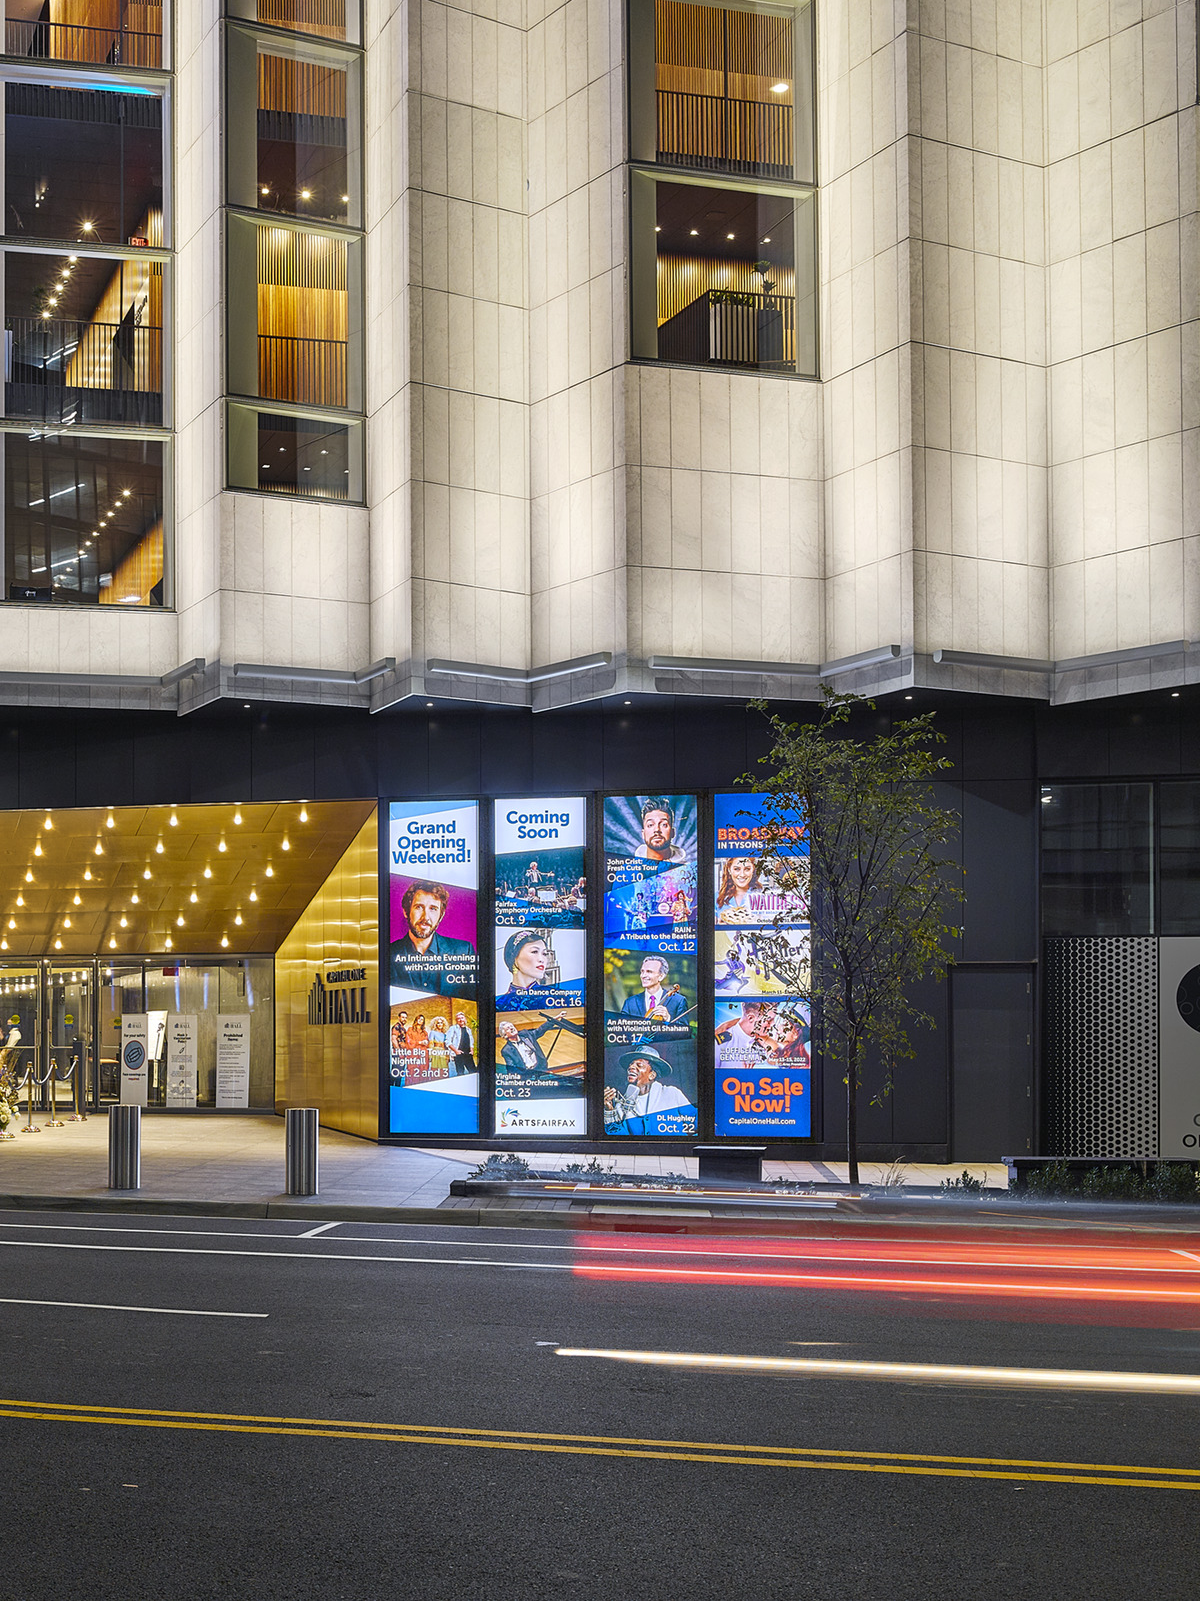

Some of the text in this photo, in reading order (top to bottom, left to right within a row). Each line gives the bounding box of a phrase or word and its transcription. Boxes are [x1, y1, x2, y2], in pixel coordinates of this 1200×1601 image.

[506, 810, 570, 827] Coming
[407, 820, 456, 835] Grand
[518, 825, 558, 839] Soon
[397, 835, 466, 852] Opening
[728, 841, 763, 849] TYSONS
[392, 849, 471, 864] Weekend!
[607, 873, 643, 883] Oct. 10
[749, 894, 807, 910] WAITRESS
[495, 915, 525, 925] Oct. 9
[658, 941, 695, 951] Oct. 12
[395, 954, 476, 963] An Intimate Evening
[404, 963, 423, 971] with
[424, 963, 444, 971] Josh
[326, 968, 368, 984] CAPITAL ONE
[446, 974, 476, 984] Oct. 1
[325, 987, 371, 1025] HALL
[545, 997, 582, 1007] Oct. 16
[607, 1033, 643, 1043] Oct. 17
[391, 1048, 411, 1056] Little
[413, 1048, 426, 1058] Big
[391, 1058, 426, 1066] Nightfall
[391, 1068, 449, 1078] Oct. 2 and 3
[722, 1077, 804, 1096] On Sale
[495, 1088, 531, 1097] Oct. 23
[734, 1095, 791, 1113] Now!
[511, 1119, 576, 1127] ARTSFAIRFAX
[728, 1117, 796, 1125] CapitalOneHall.com
[658, 1123, 695, 1133] Oct. 22
